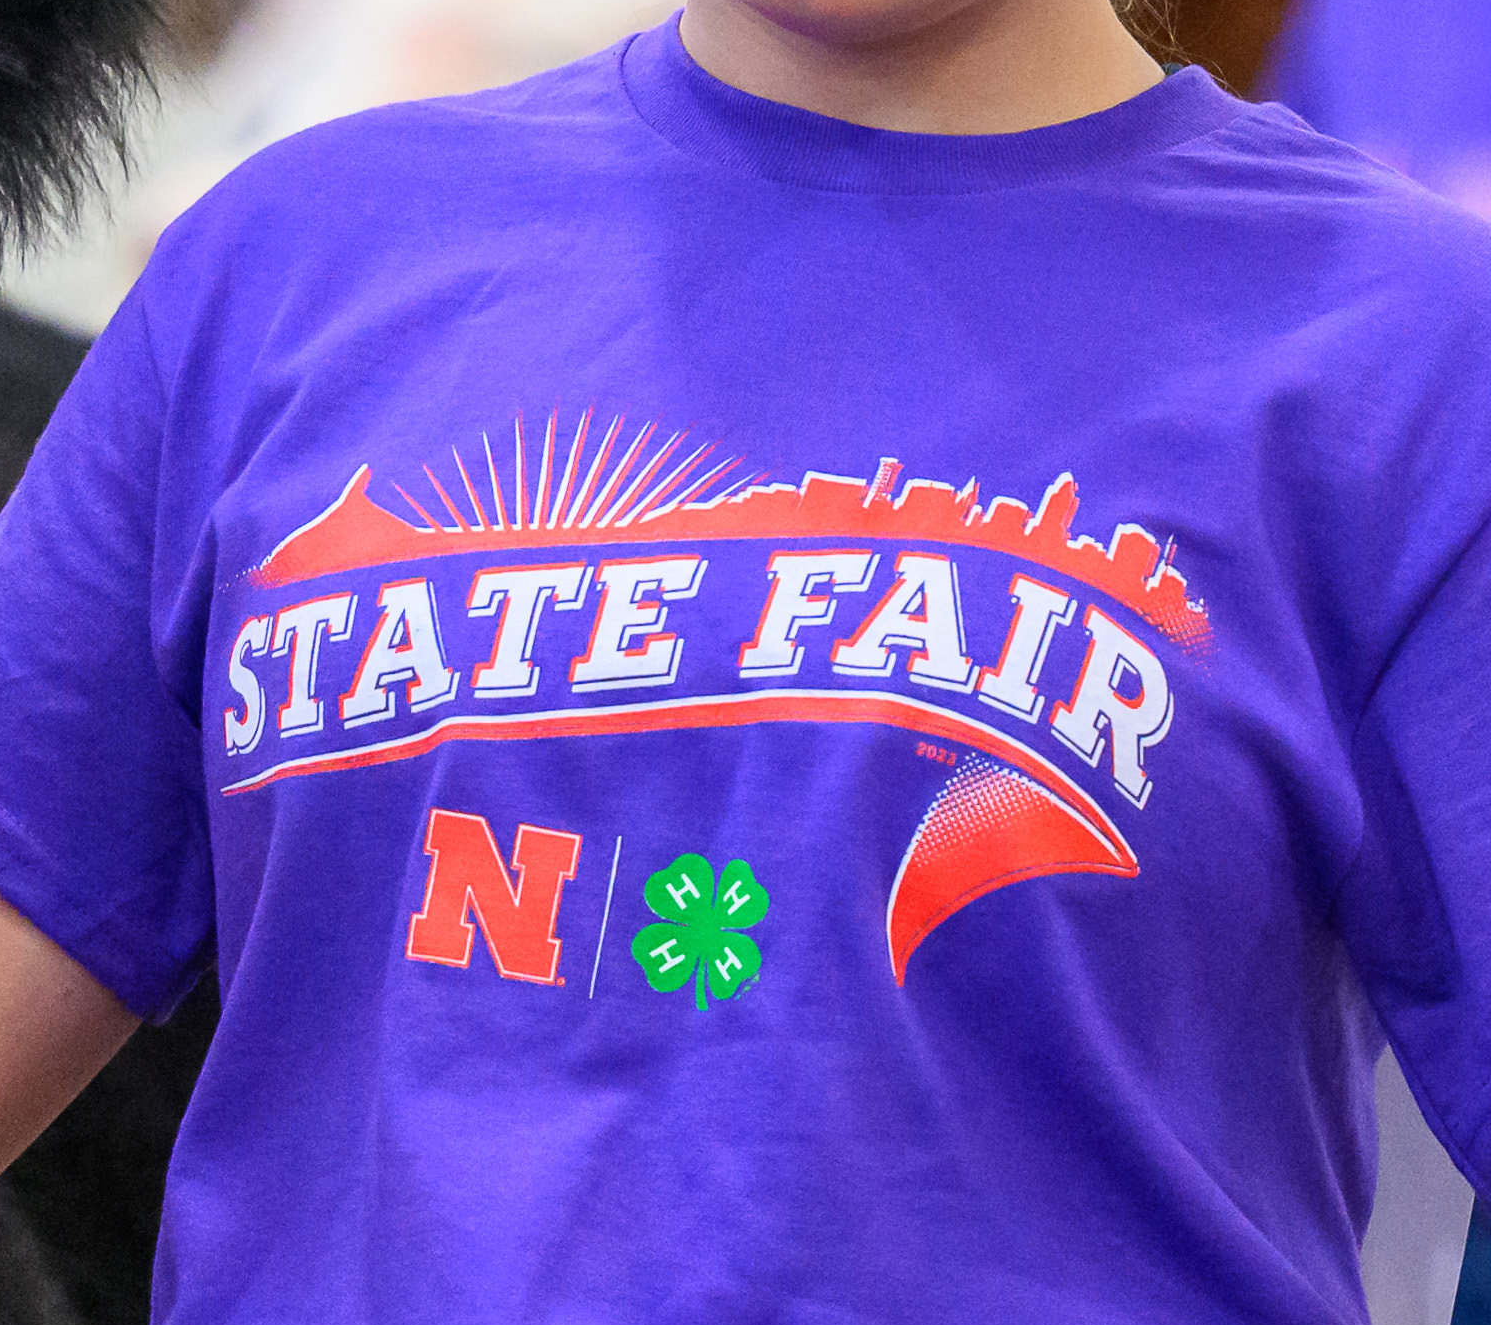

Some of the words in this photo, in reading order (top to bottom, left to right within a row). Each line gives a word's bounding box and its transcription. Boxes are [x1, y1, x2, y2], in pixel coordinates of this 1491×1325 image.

[224, 554, 708, 756] STATE
[737, 548, 1175, 810] FAIR
[405, 807, 582, 985] N
[665, 873, 701, 910] H
[722, 880, 751, 916] H
[648, 938, 686, 974] H
[714, 946, 743, 982] H
